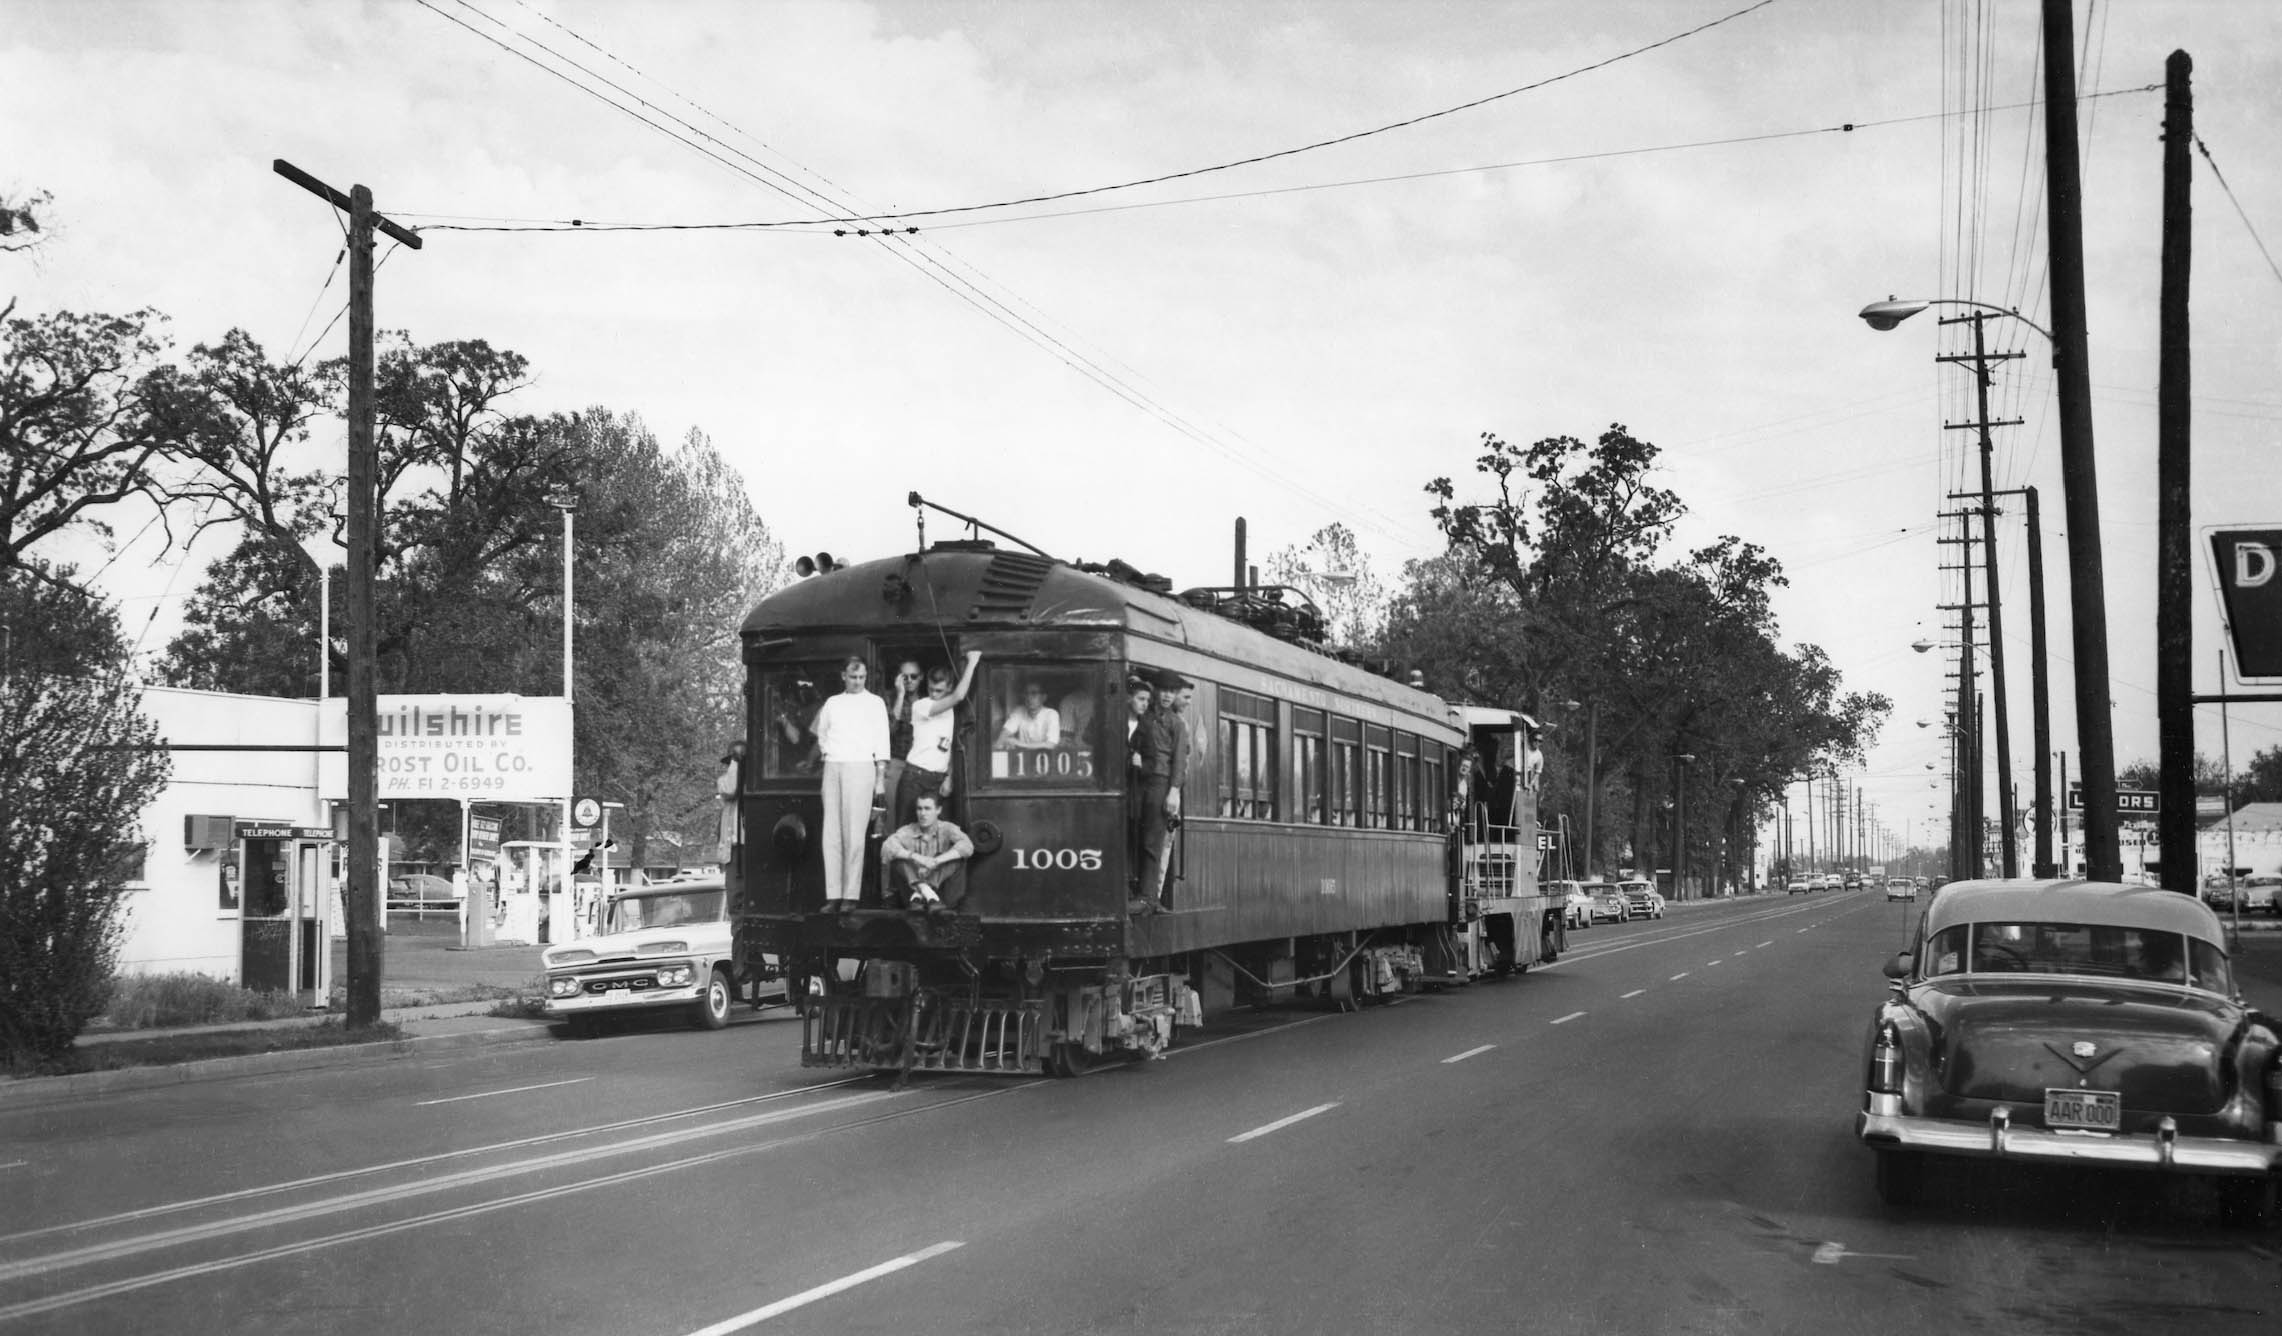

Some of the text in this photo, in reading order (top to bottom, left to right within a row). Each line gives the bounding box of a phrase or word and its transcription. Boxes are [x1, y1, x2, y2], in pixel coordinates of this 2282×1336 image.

[384, 740, 484, 749] DISTRIBUTED
[377, 755, 432, 773] ROST
[1015, 751, 1093, 777] 1005
[388, 776, 505, 790] PH. FI 2-6949
[242, 828, 293, 838] TELEPHONE
[303, 829, 334, 838] TELEPHONE
[1012, 848, 1103, 870] 1005
[592, 978, 649, 991] GMC
[2050, 1101, 2083, 1122] AAR
